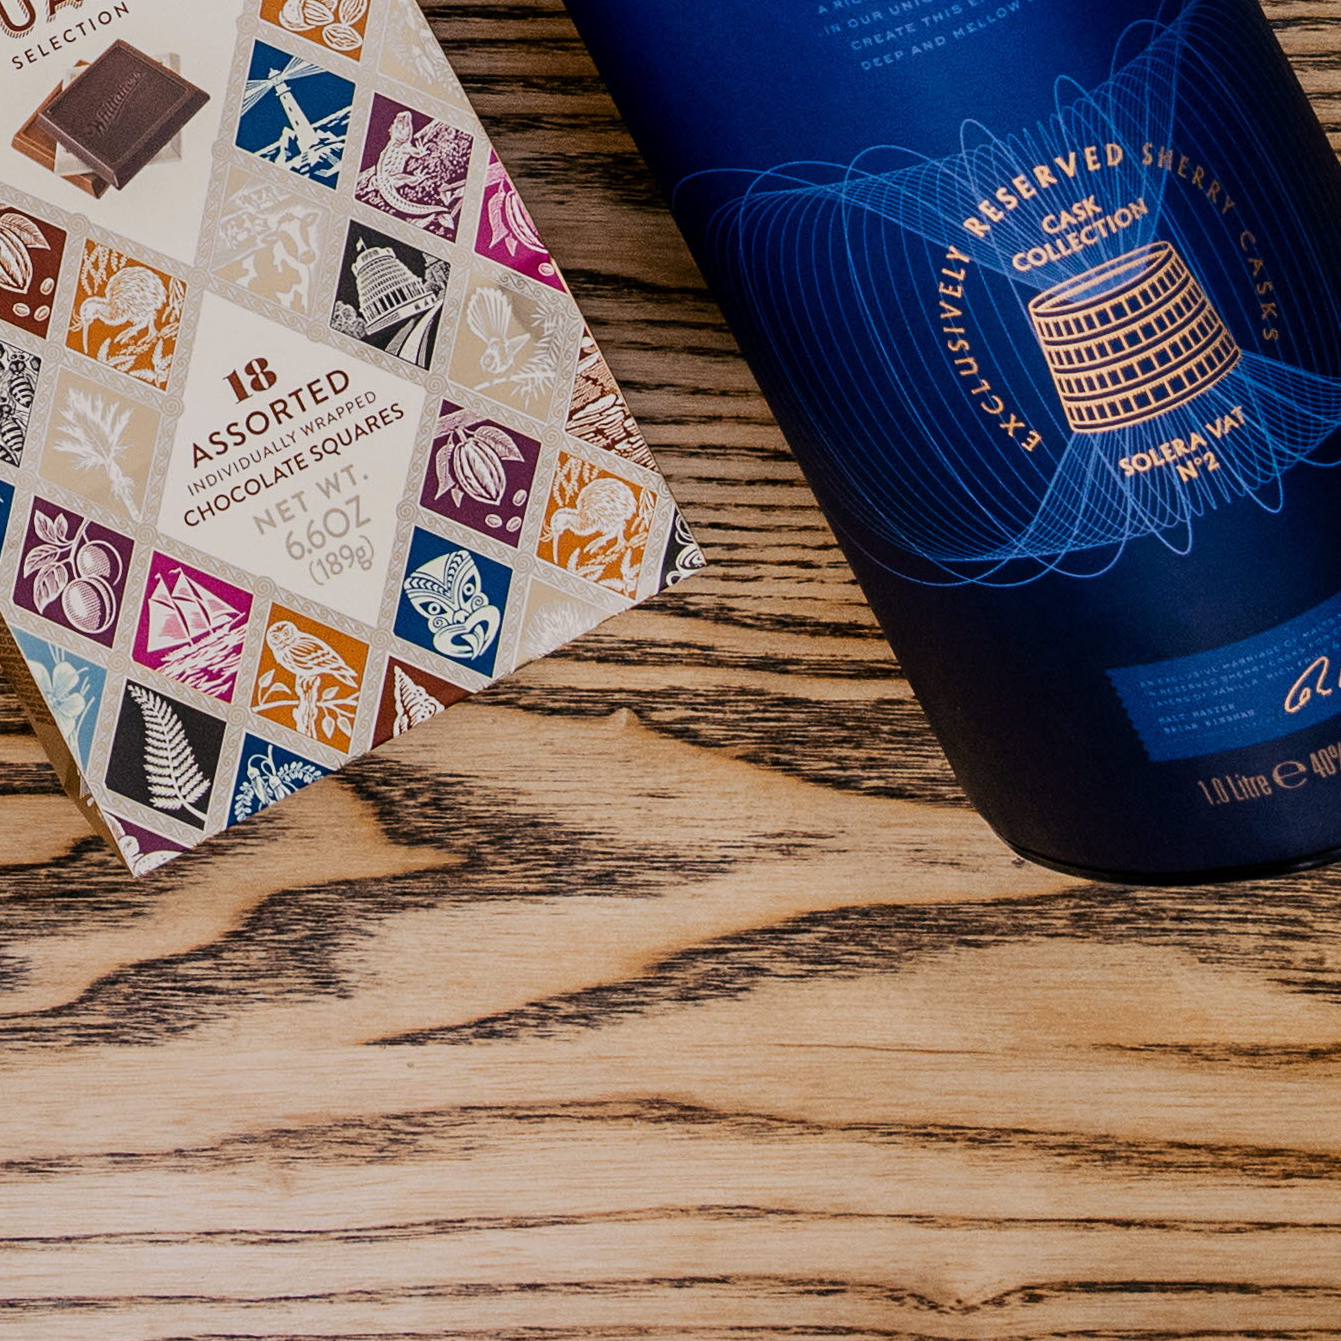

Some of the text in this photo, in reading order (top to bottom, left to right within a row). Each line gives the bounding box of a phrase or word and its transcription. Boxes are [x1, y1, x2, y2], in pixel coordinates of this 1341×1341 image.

[11, 2, 129, 70] SELECTION
[851, 23, 916, 50] CREATE
[952, 0, 1019, 40] MELLOW
[963, 141, 1278, 342] RESERVED SHERRY CASKS
[1012, 197, 1148, 273] COLLECTION
[1041, 195, 1102, 235] CASK
[222, 357, 277, 404] 18
[939, 245, 1043, 453] EXCLUSIVELY
[187, 390, 376, 495] INDIVIDUALLY WRAPPED
[193, 369, 350, 468] ASSORTED
[1118, 405, 1247, 478] SOLERA VAT
[183, 403, 404, 527] CHOCOLATE SQUARES
[252, 465, 368, 535] NET WT.
[285, 495, 371, 560] 6.6OZ
[309, 535, 375, 586] (189g)
[1226, 773, 1272, 801] Litre
